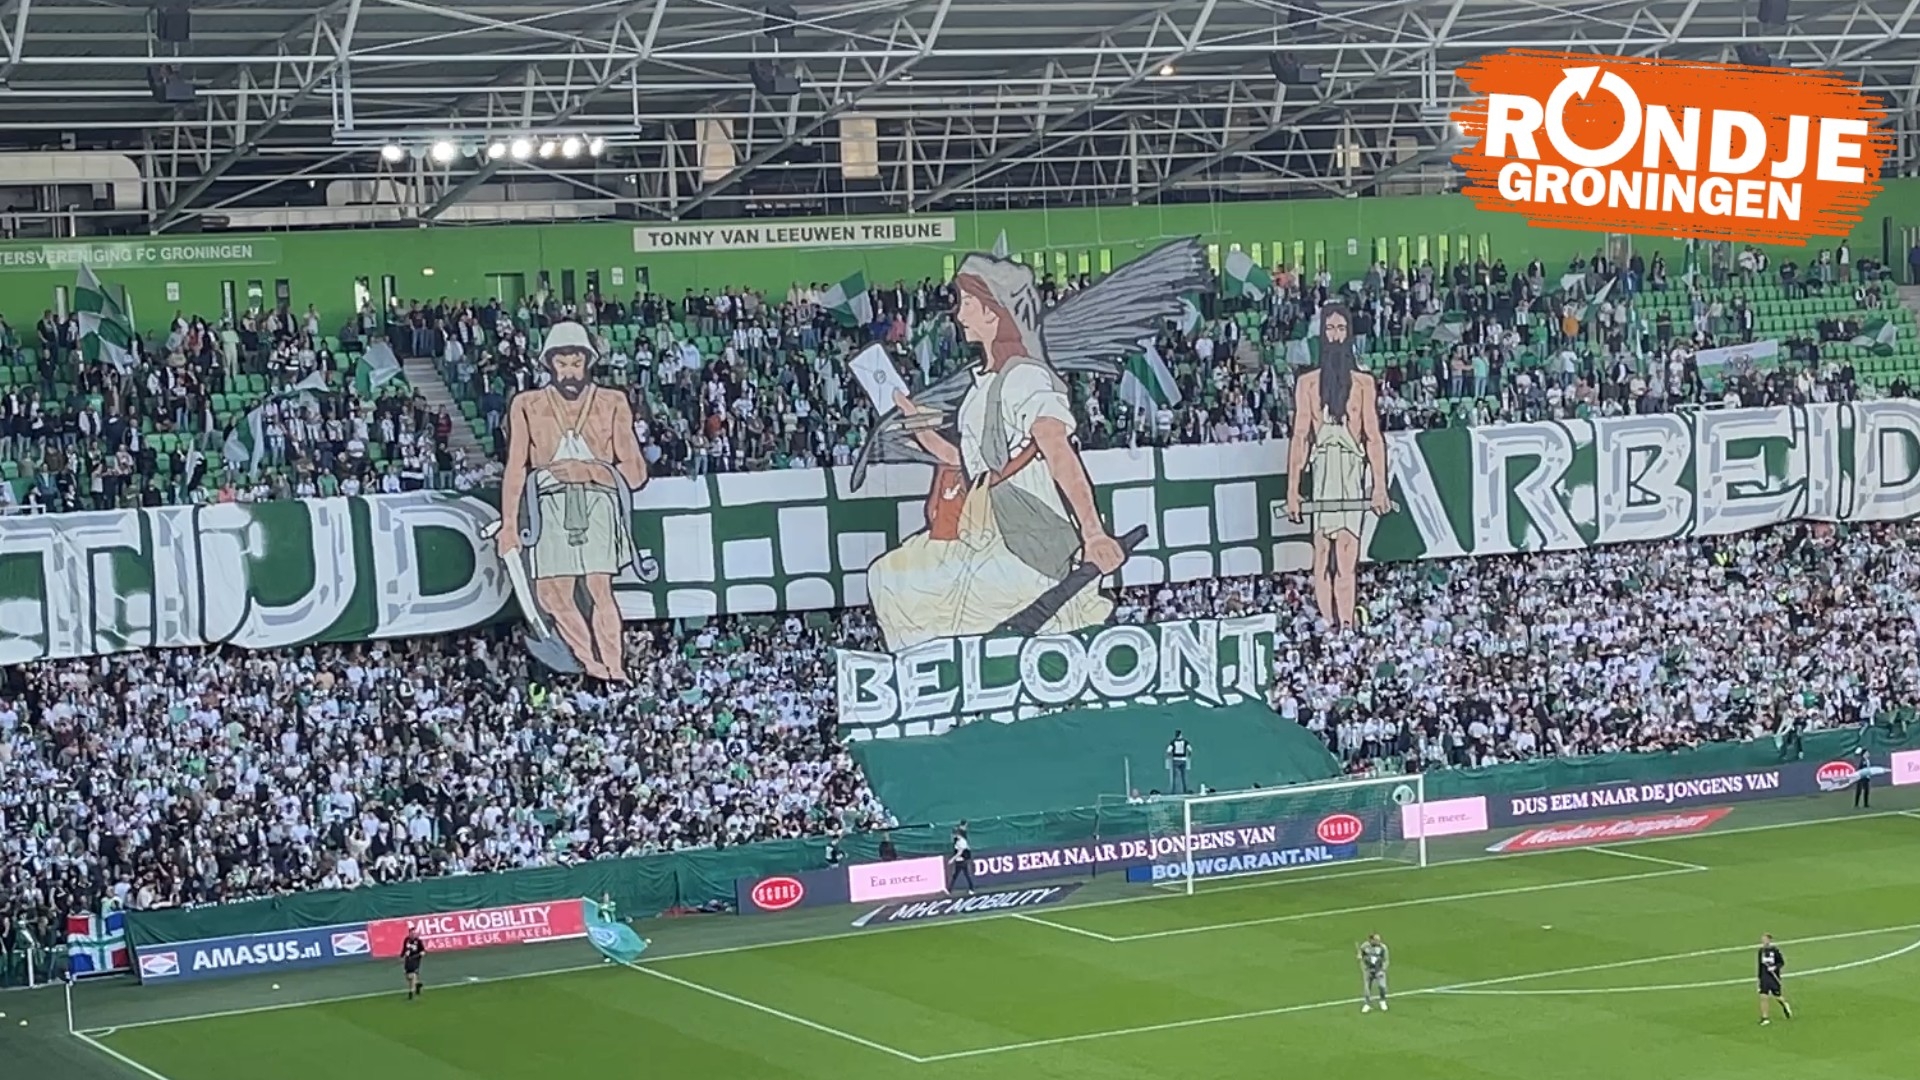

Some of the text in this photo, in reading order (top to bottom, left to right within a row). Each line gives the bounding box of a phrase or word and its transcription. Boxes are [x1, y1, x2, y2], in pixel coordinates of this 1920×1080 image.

[648, 223, 942, 248] TONNY VAN LEEUWEN TRIBUNE
[136, 247, 157, 262] FC
[161, 244, 254, 260] GRONINGEN
[1360, 398, 1920, 562] ARBEID
[837, 612, 1277, 724] BELOONT
[1511, 771, 1780, 815] DUS EEM NAAR DE JONGENS VAN
[973, 826, 1277, 876] DUS EEM NAAR DE JONGENS VAN
[1152, 846, 1334, 880] BOUWGARANT.NL
[758, 884, 797, 902] SCORE
[889, 887, 1061, 920] MHC MOBILITY
[407, 906, 551, 936] MHC MOBILITY
[468, 932, 502, 946] LEUK
[505, 927, 553, 942] MAKEN
[192, 940, 322, 970] AMASUS.nl
